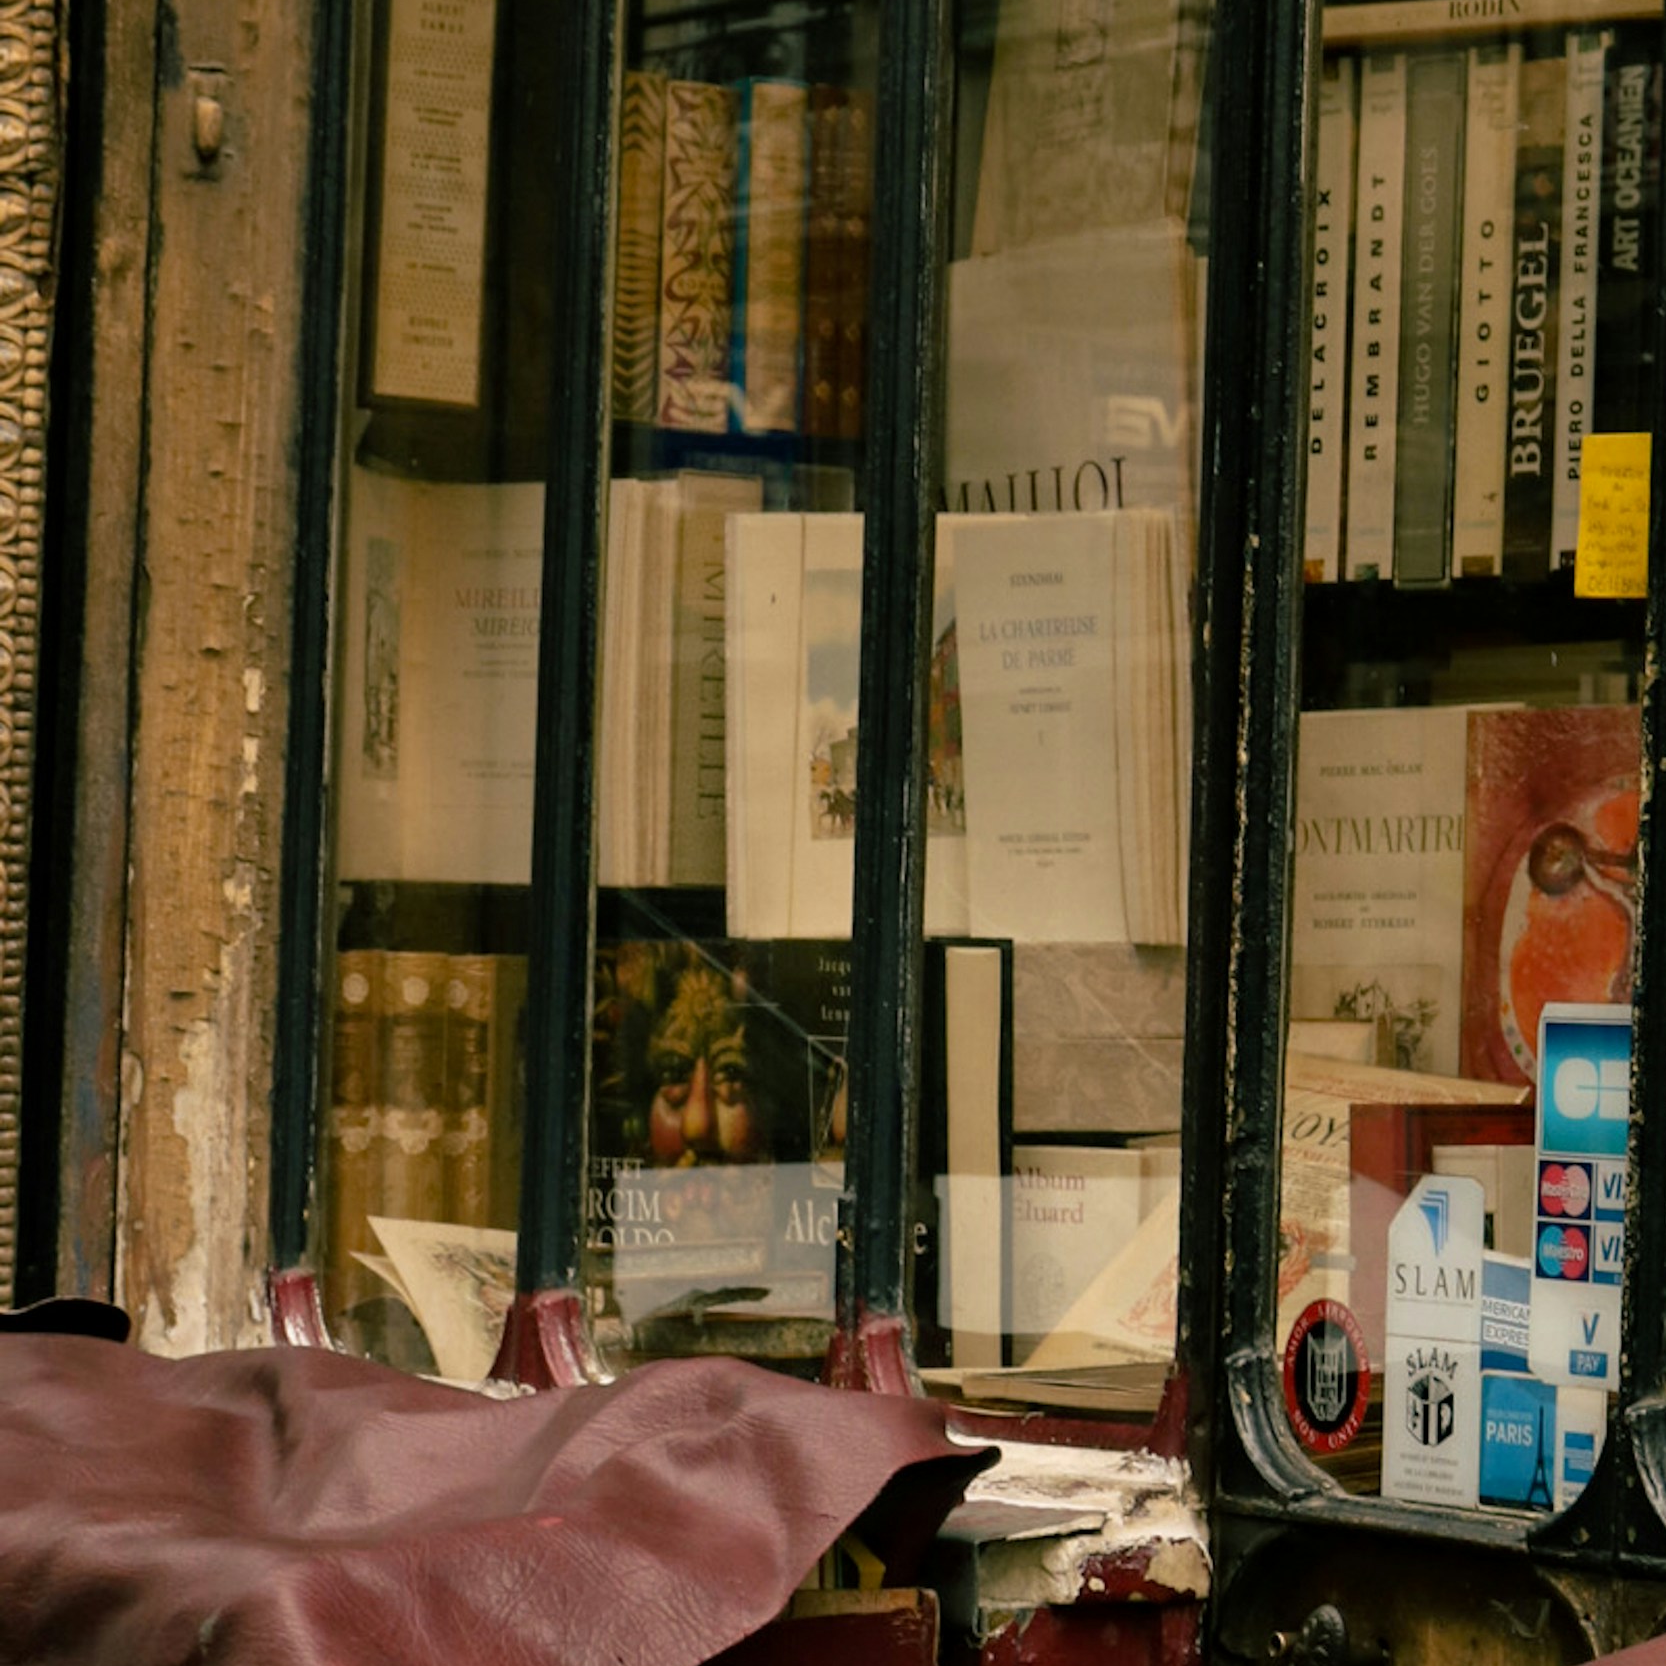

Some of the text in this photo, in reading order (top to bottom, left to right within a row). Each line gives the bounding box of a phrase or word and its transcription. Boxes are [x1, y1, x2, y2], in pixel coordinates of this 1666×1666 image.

[1421, 145, 1439, 208] GOES
[1612, 229, 1640, 271] ART
[1364, 175, 1386, 461] REMBRANDT
[1416, 279, 1437, 338] VAN
[1475, 217, 1495, 406] GIOTTO
[1567, 113, 1593, 481] PIERO DELLA FRANCESCA
[1310, 190, 1333, 456] DELACROIX
[1511, 221, 1549, 478] BRUEGEL
[1413, 343, 1434, 426] HUGO
[979, 615, 1099, 642] LA CHARTREUSE
[1002, 646, 1075, 671] DE PARME
[1012, 1166, 1087, 1192] Album
[1543, 1239, 1585, 1264] Maestro
[1395, 1264, 1475, 1301] SLAM
[1287, 1318, 1309, 1368] AMOR
[1406, 1347, 1459, 1380] SLAM
[1576, 1354, 1602, 1372] PAY
[1486, 1419, 1534, 1448] PARIS
